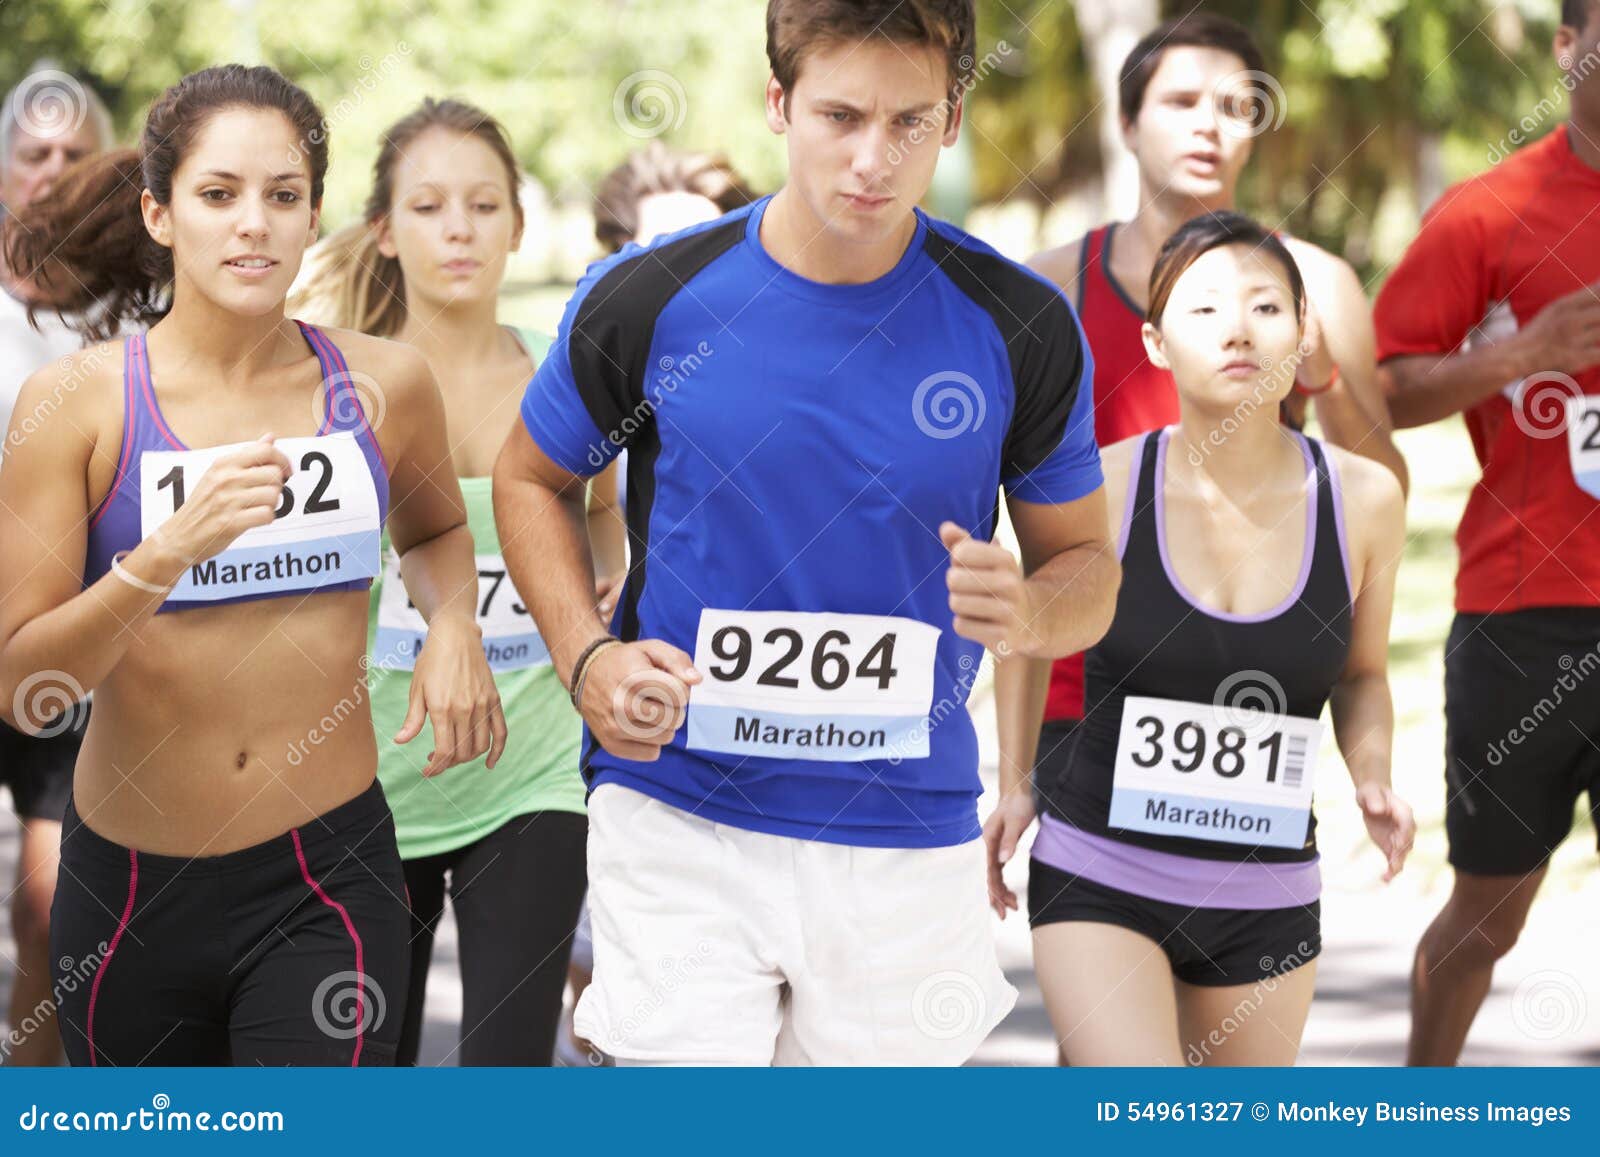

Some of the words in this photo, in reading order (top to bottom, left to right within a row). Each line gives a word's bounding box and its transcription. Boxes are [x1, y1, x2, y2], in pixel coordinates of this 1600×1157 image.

[157, 451, 340, 520] 12
[191, 551, 341, 586] Marathon
[709, 625, 898, 690] 9264
[734, 717, 886, 747] Marathon
[1131, 716, 1283, 783] 3981
[1145, 799, 1271, 834] Marathon
